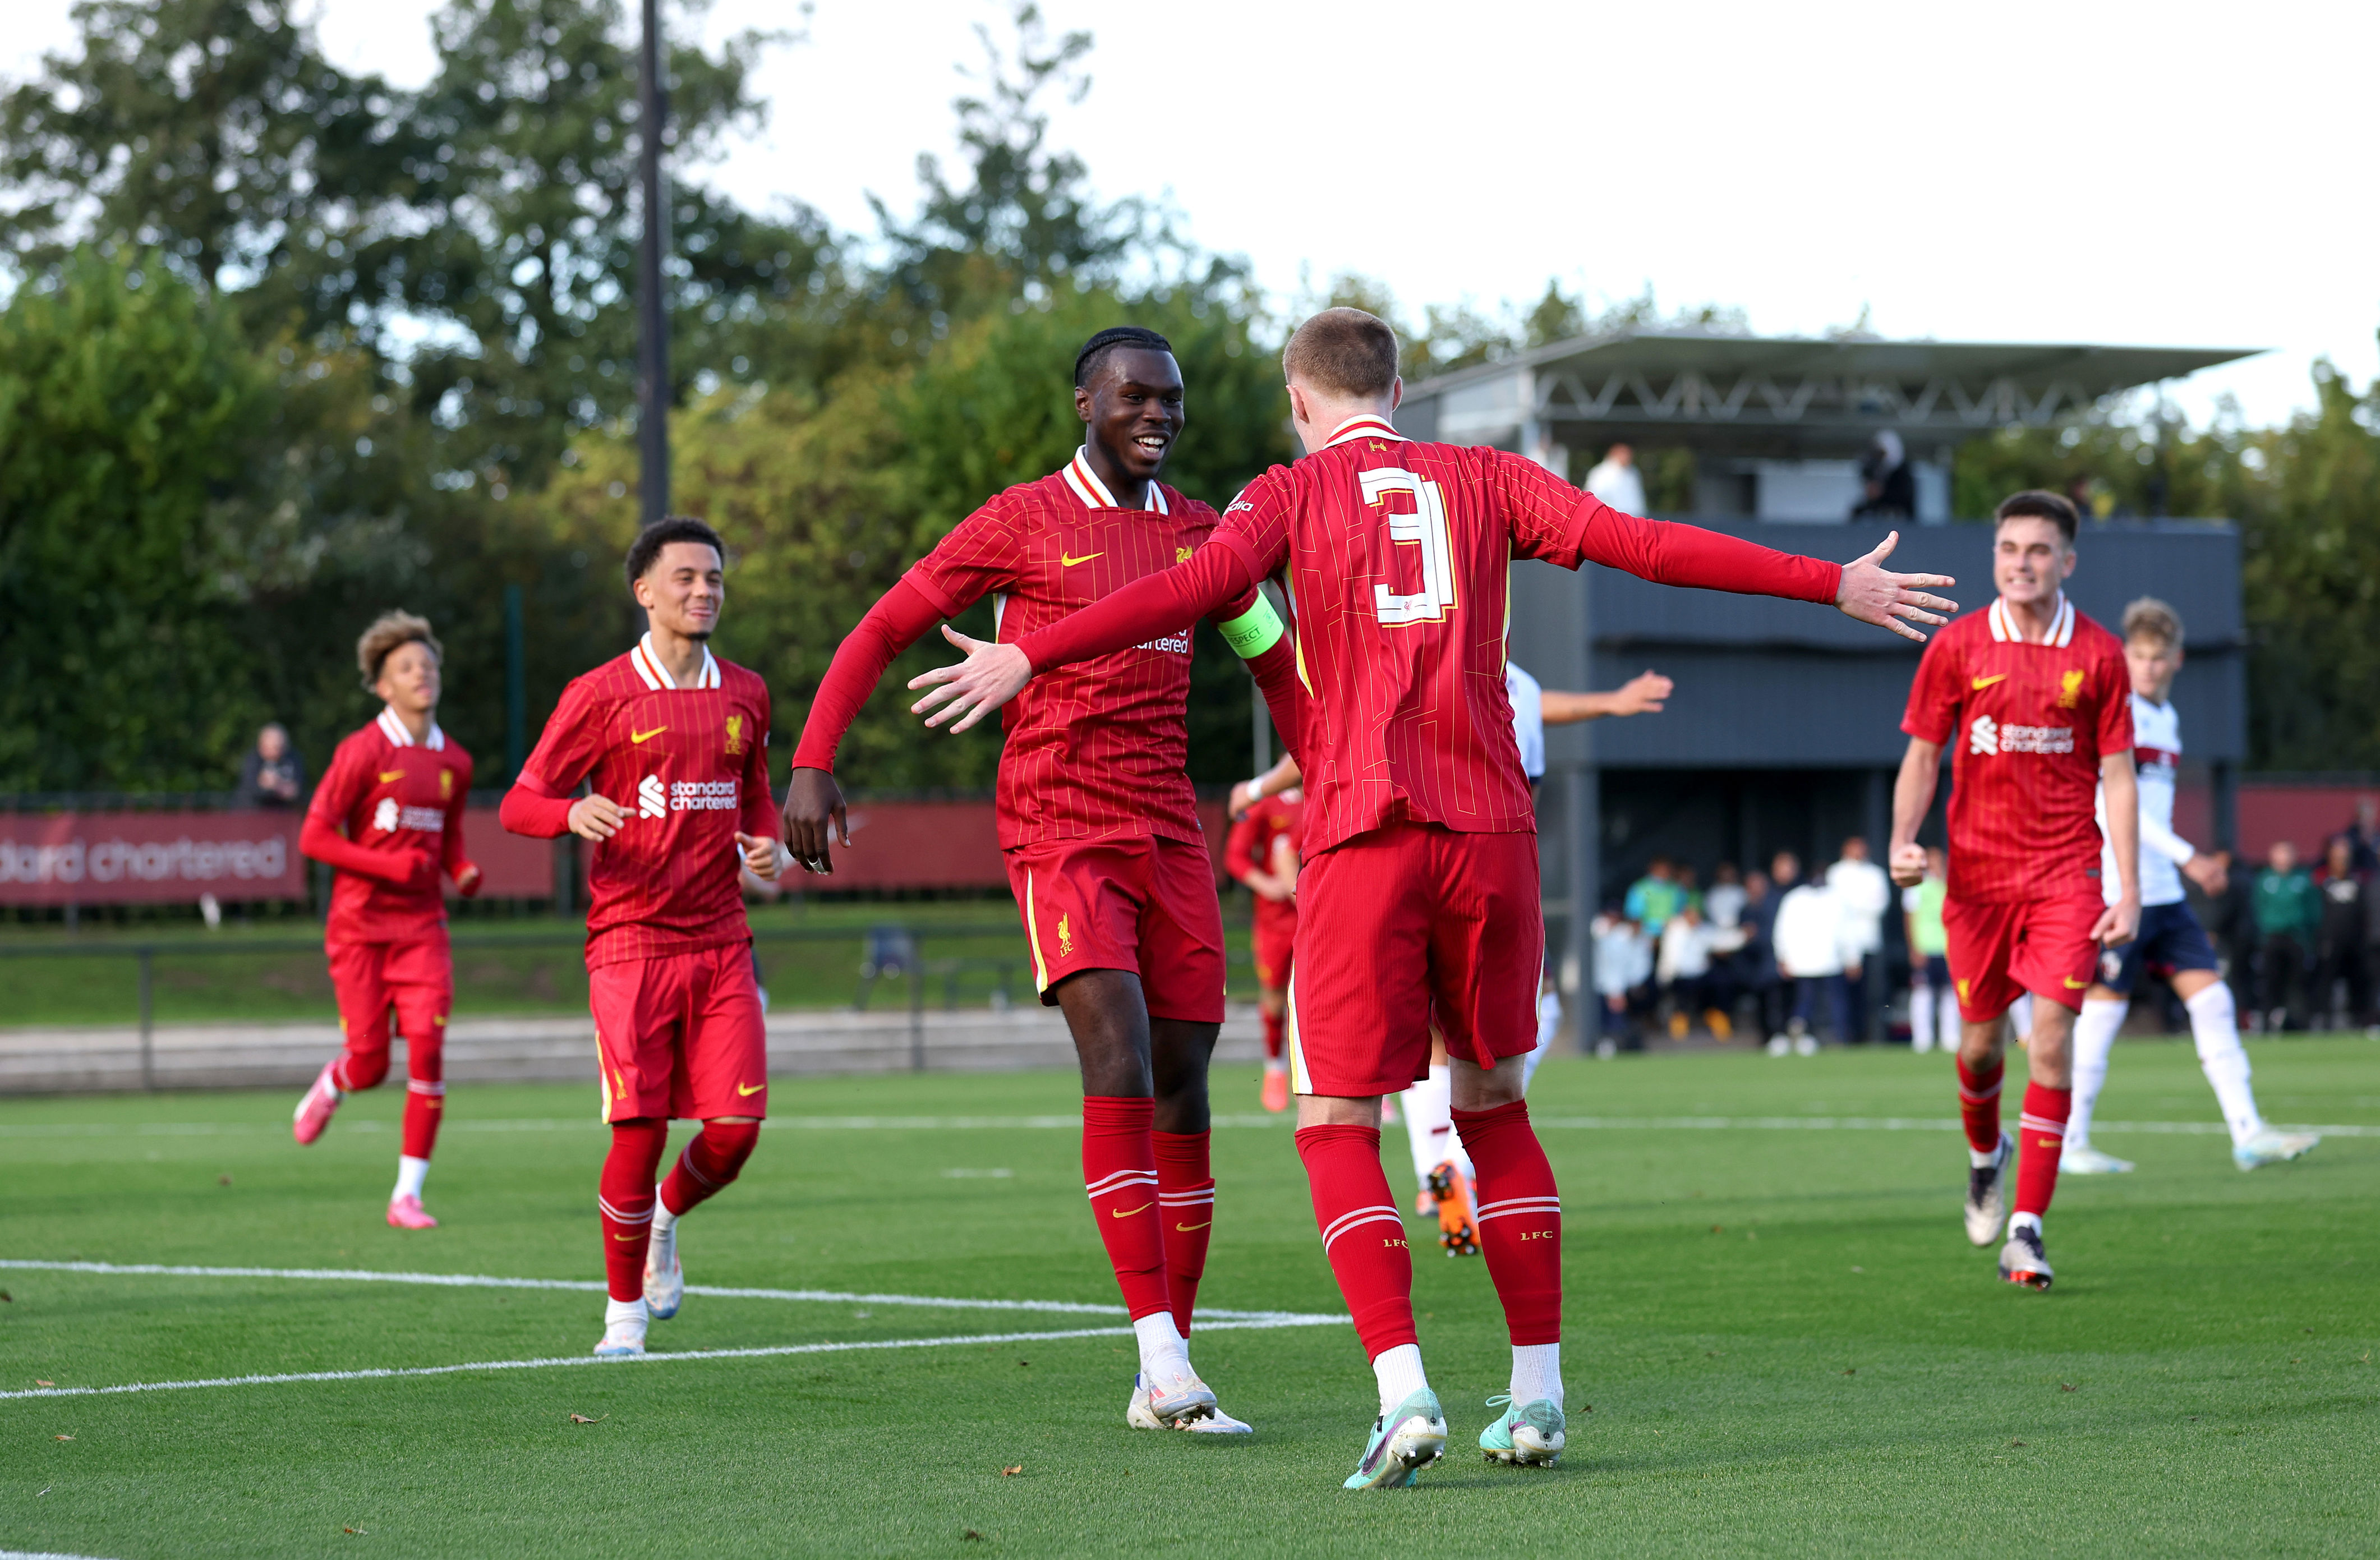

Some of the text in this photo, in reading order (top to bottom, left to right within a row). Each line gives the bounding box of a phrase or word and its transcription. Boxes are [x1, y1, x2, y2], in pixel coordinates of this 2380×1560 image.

[1358, 467, 1457, 625] 3
[2000, 722, 2073, 740] standard
[1999, 737, 2074, 754] chartered
[670, 779, 736, 797] standard
[670, 794, 738, 811] chartered
[88, 834, 286, 882] chartered
[1383, 1239, 1408, 1249] LFC
[1520, 1231, 1553, 1241] LFC
